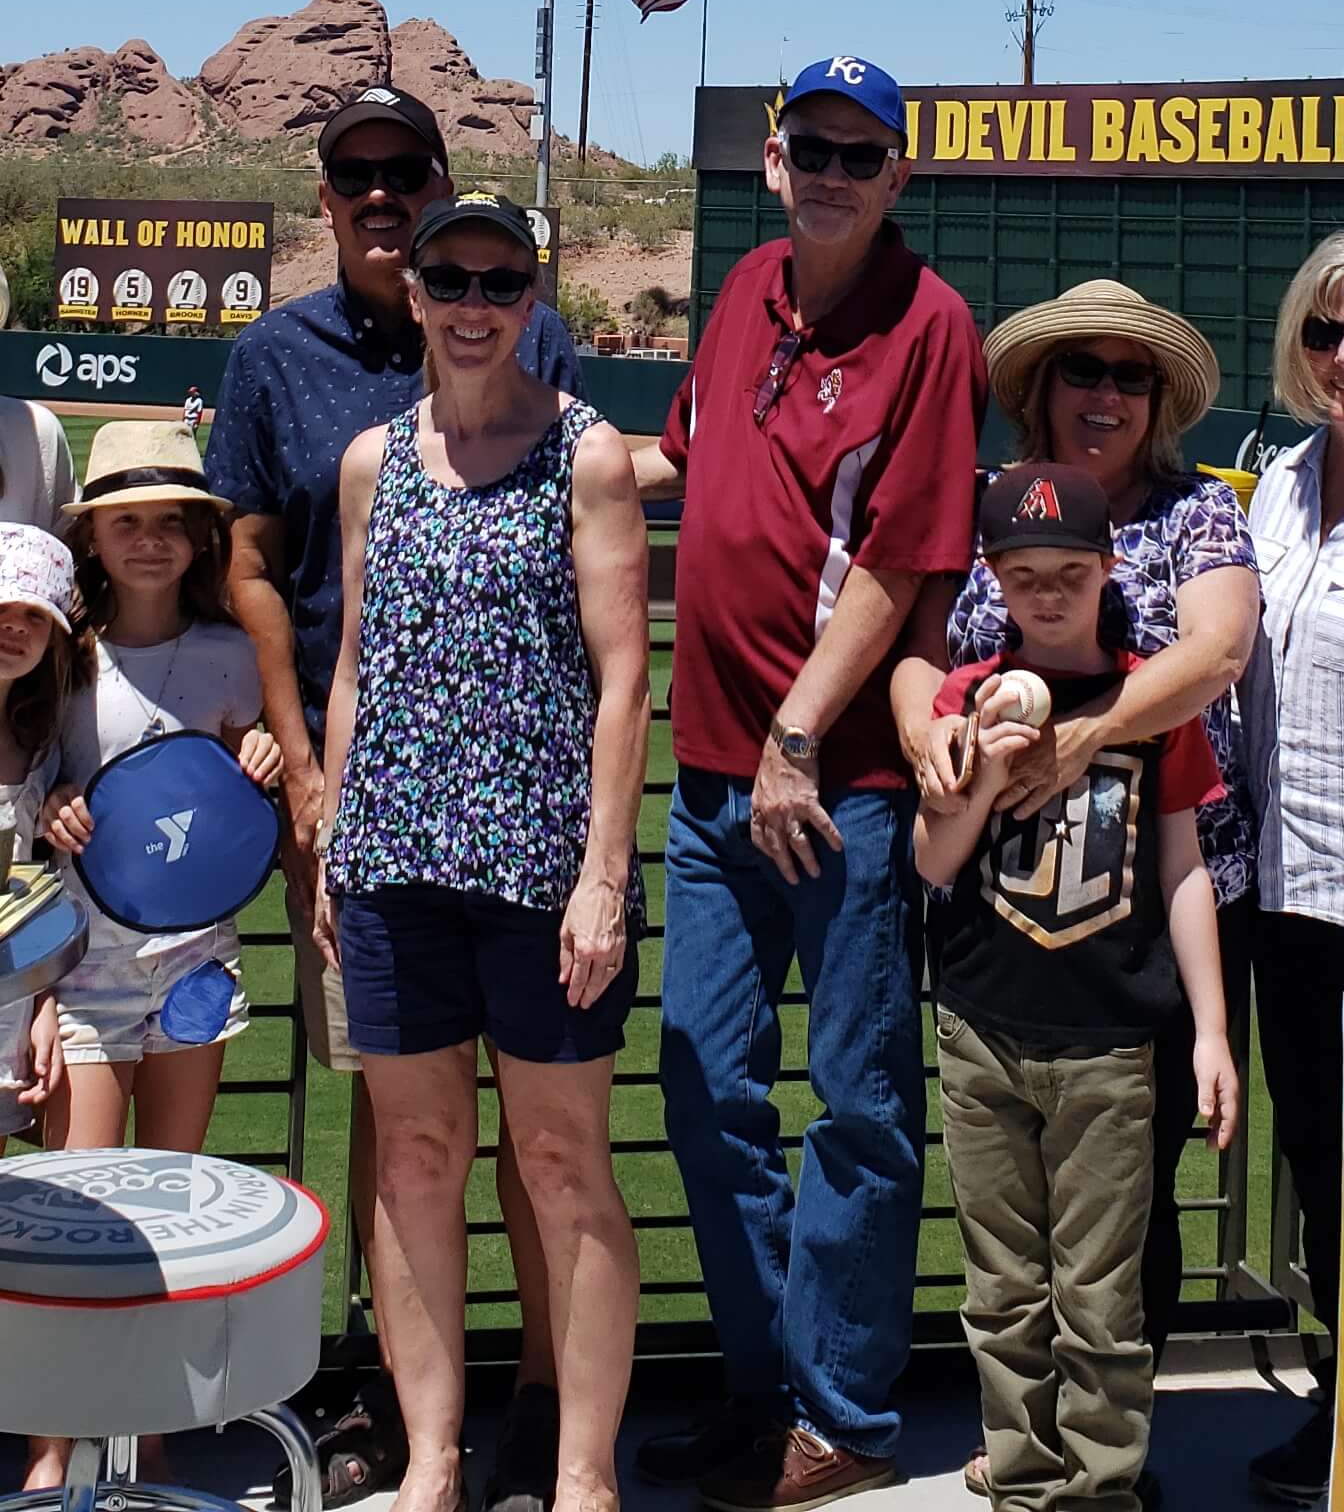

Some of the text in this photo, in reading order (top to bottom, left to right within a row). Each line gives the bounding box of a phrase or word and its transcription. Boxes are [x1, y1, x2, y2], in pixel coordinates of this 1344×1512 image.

[825, 56, 866, 85] KC
[932, 99, 1077, 162] DEVIL
[60, 218, 266, 249] WALL OF HONOR
[68, 275, 249, 302] 19 5 7 9
[169, 311, 204, 319] BROOKS
[230, 312, 253, 320] DAVIS
[77, 353, 137, 389] aps
[145, 842, 164, 855] the
[213, 1163, 269, 1201] BORN
[219, 1199, 263, 1219] IN
[144, 1214, 234, 1240] THE
